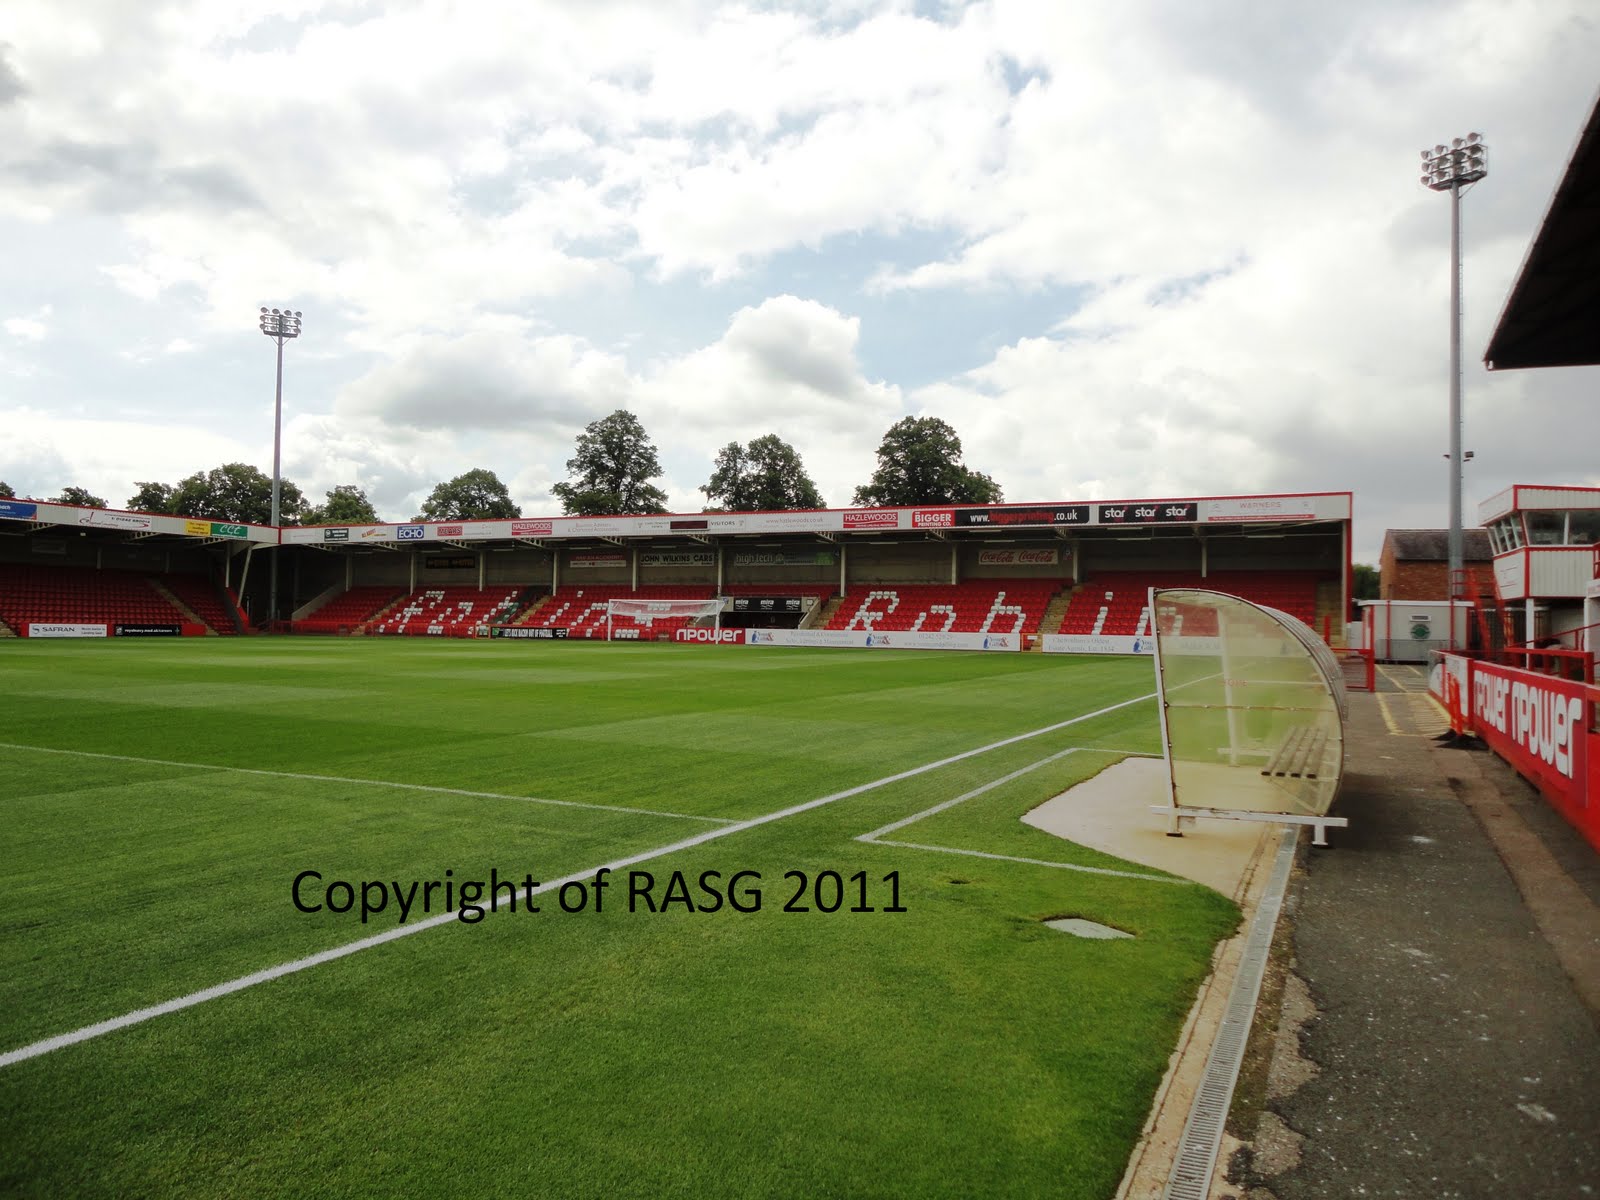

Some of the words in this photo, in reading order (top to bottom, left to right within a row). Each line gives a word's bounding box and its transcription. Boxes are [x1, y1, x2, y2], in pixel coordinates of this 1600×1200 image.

[1104, 508, 1126, 518] star
[1134, 507, 1156, 517] star
[1165, 506, 1188, 516] star
[844, 513, 897, 522] HAZLEWOODS
[914, 513, 952, 522] BIGGER
[970, 509, 1078, 525] www.biggerprinting.co.uk
[512, 522, 552, 530] HAZLEWOODS
[398, 529, 424, 538] ECHO
[662, 554, 691, 562] WILKINS
[676, 628, 742, 642] npower
[1474, 669, 1510, 735] npower
[1511, 680, 1582, 780] npower
